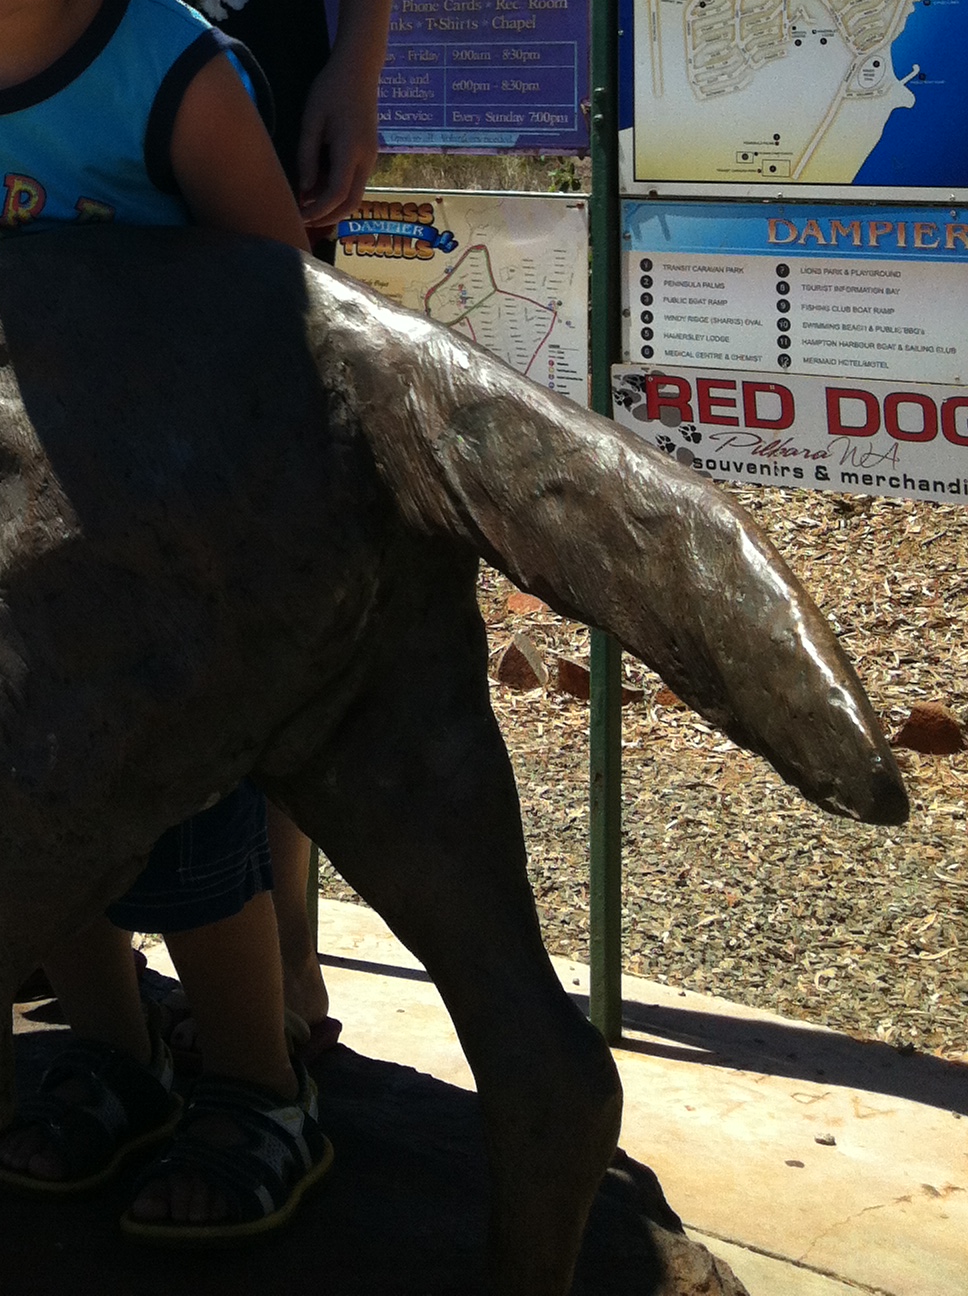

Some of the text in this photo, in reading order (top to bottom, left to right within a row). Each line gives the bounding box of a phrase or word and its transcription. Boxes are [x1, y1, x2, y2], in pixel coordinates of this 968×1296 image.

[402, 0, 439, 12] Phone
[492, 15, 536, 31] Chapel
[408, 50, 440, 62] Friday
[410, 73, 430, 85] and
[392, 87, 434, 100] Holidays
[394, 110, 433, 121] Service
[485, 111, 526, 126] Sunday
[529, 112, 568, 126] 7:00pm
[351, 200, 434, 225] TNESS
[348, 221, 424, 236] DAMPIER
[767, 217, 968, 250] DAMPIER
[340, 234, 434, 260] TRAILS
[851, 270, 901, 278] PLAYGROUND
[801, 284, 832, 292] TOURIST
[834, 286, 884, 294] INFORMATION
[706, 334, 730, 342] LODGE
[665, 350, 694, 358] MEDICAL
[645, 374, 795, 430] RED
[709, 431, 831, 461] Pilbara
[693, 457, 804, 479] souvenirs
[814, 465, 831, 481] &
